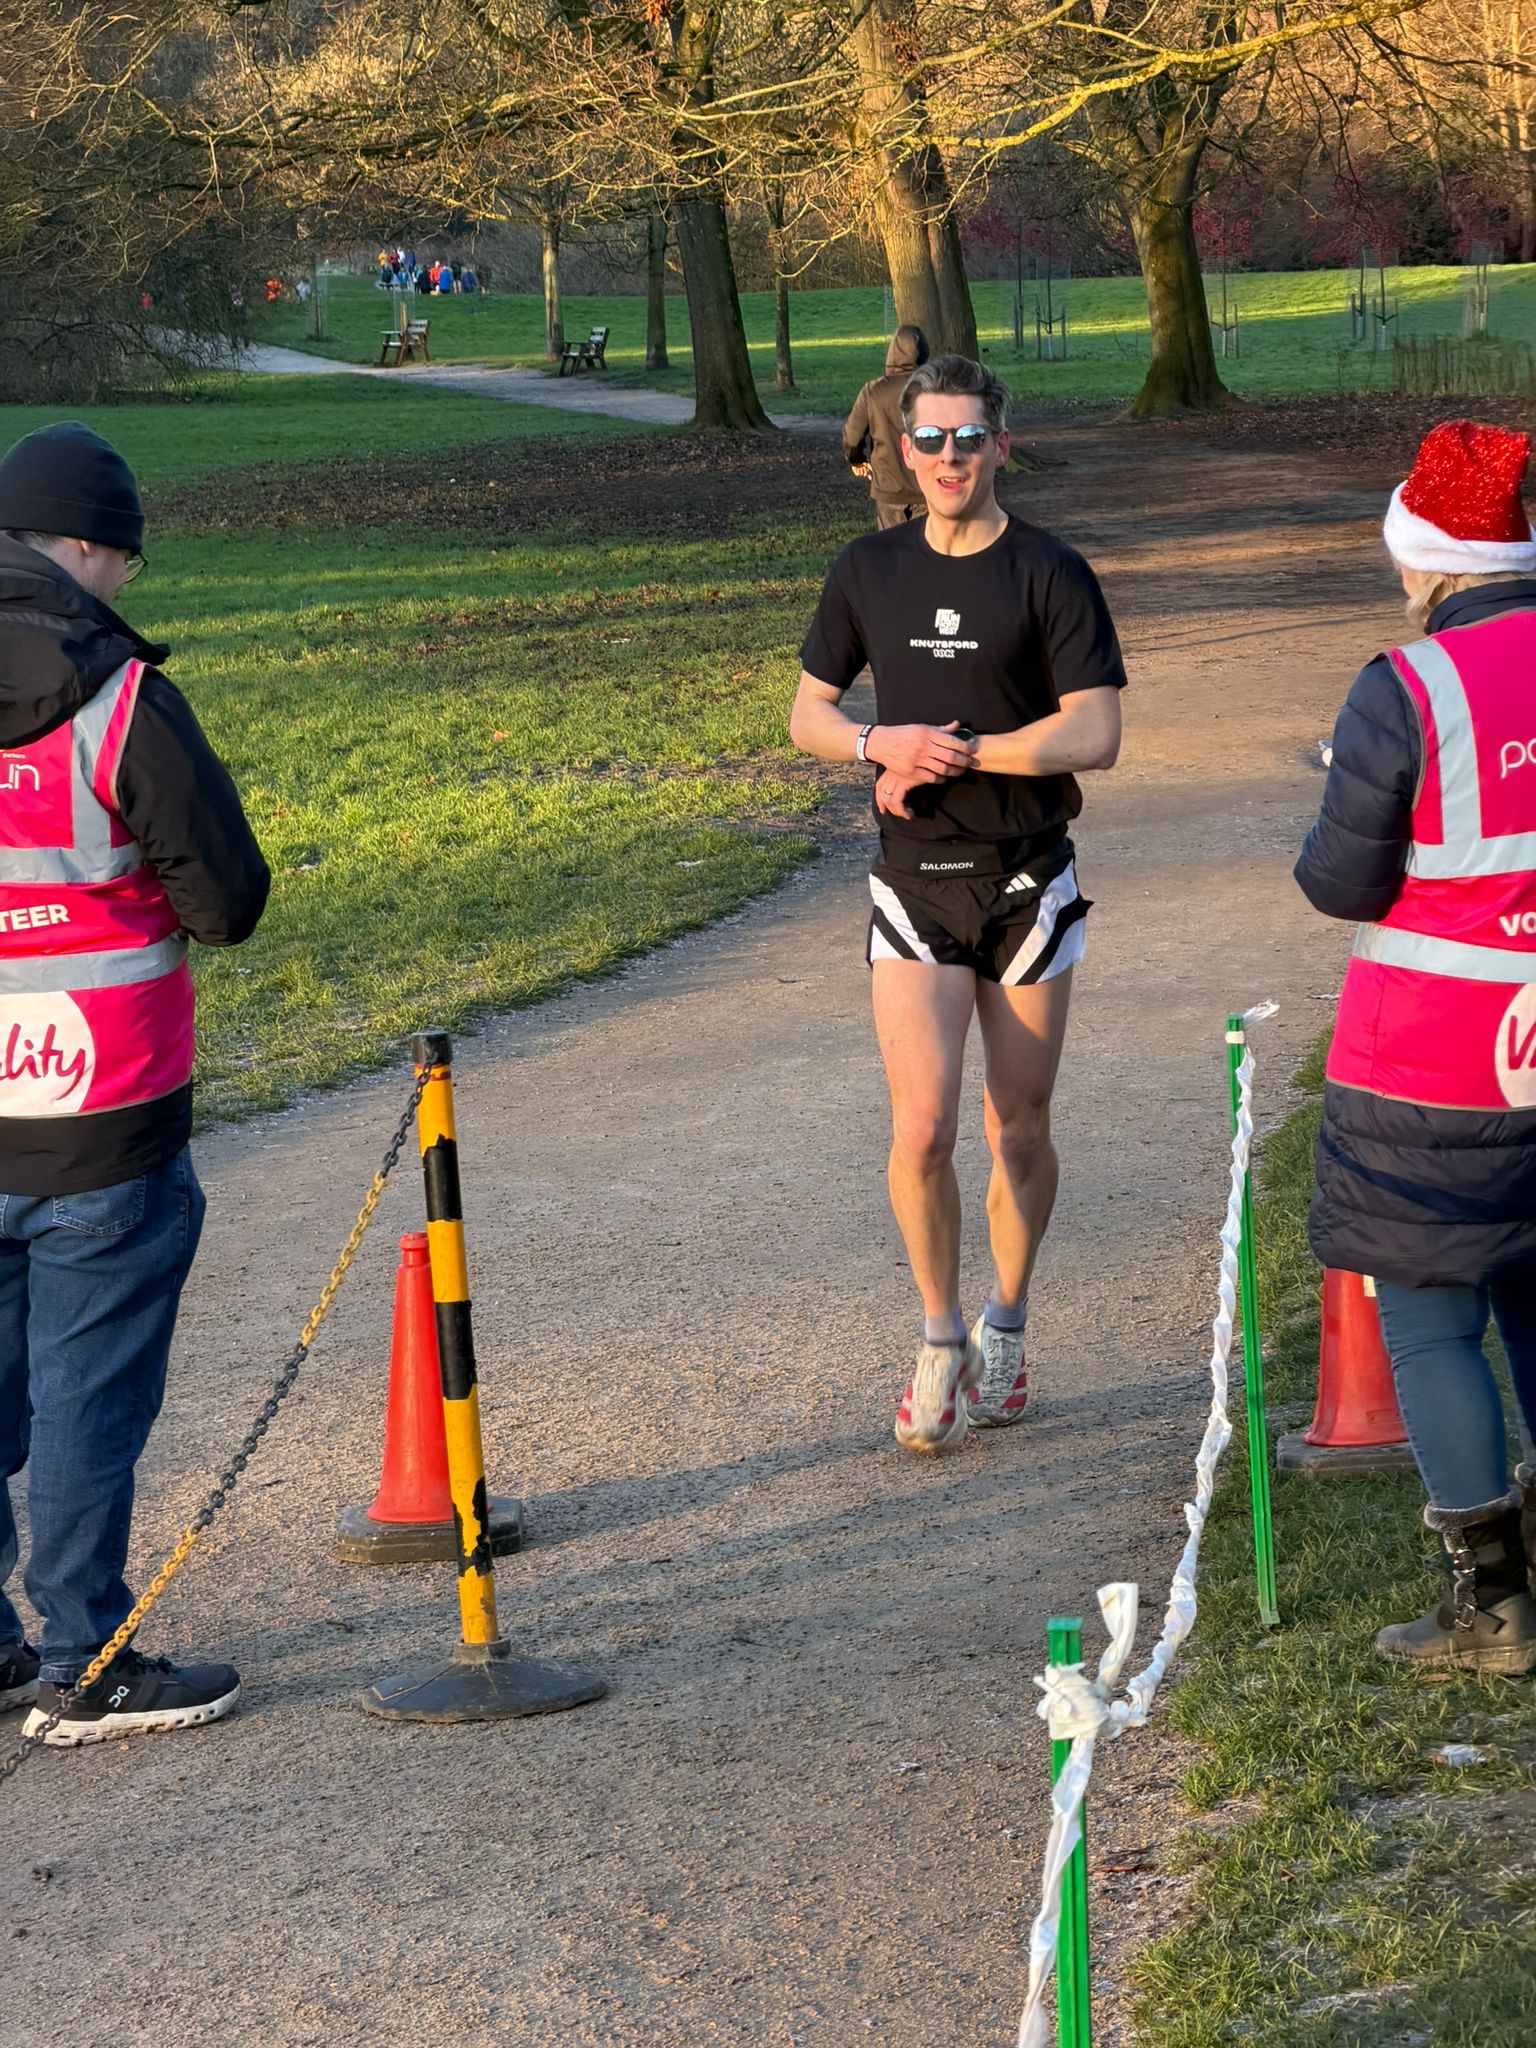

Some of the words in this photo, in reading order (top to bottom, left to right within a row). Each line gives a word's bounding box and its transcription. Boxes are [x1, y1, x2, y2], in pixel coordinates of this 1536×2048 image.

[910, 639, 979, 650] KNUTSFORD
[920, 861, 974, 871] SALOMON
[0, 1023, 86, 1100] lity
